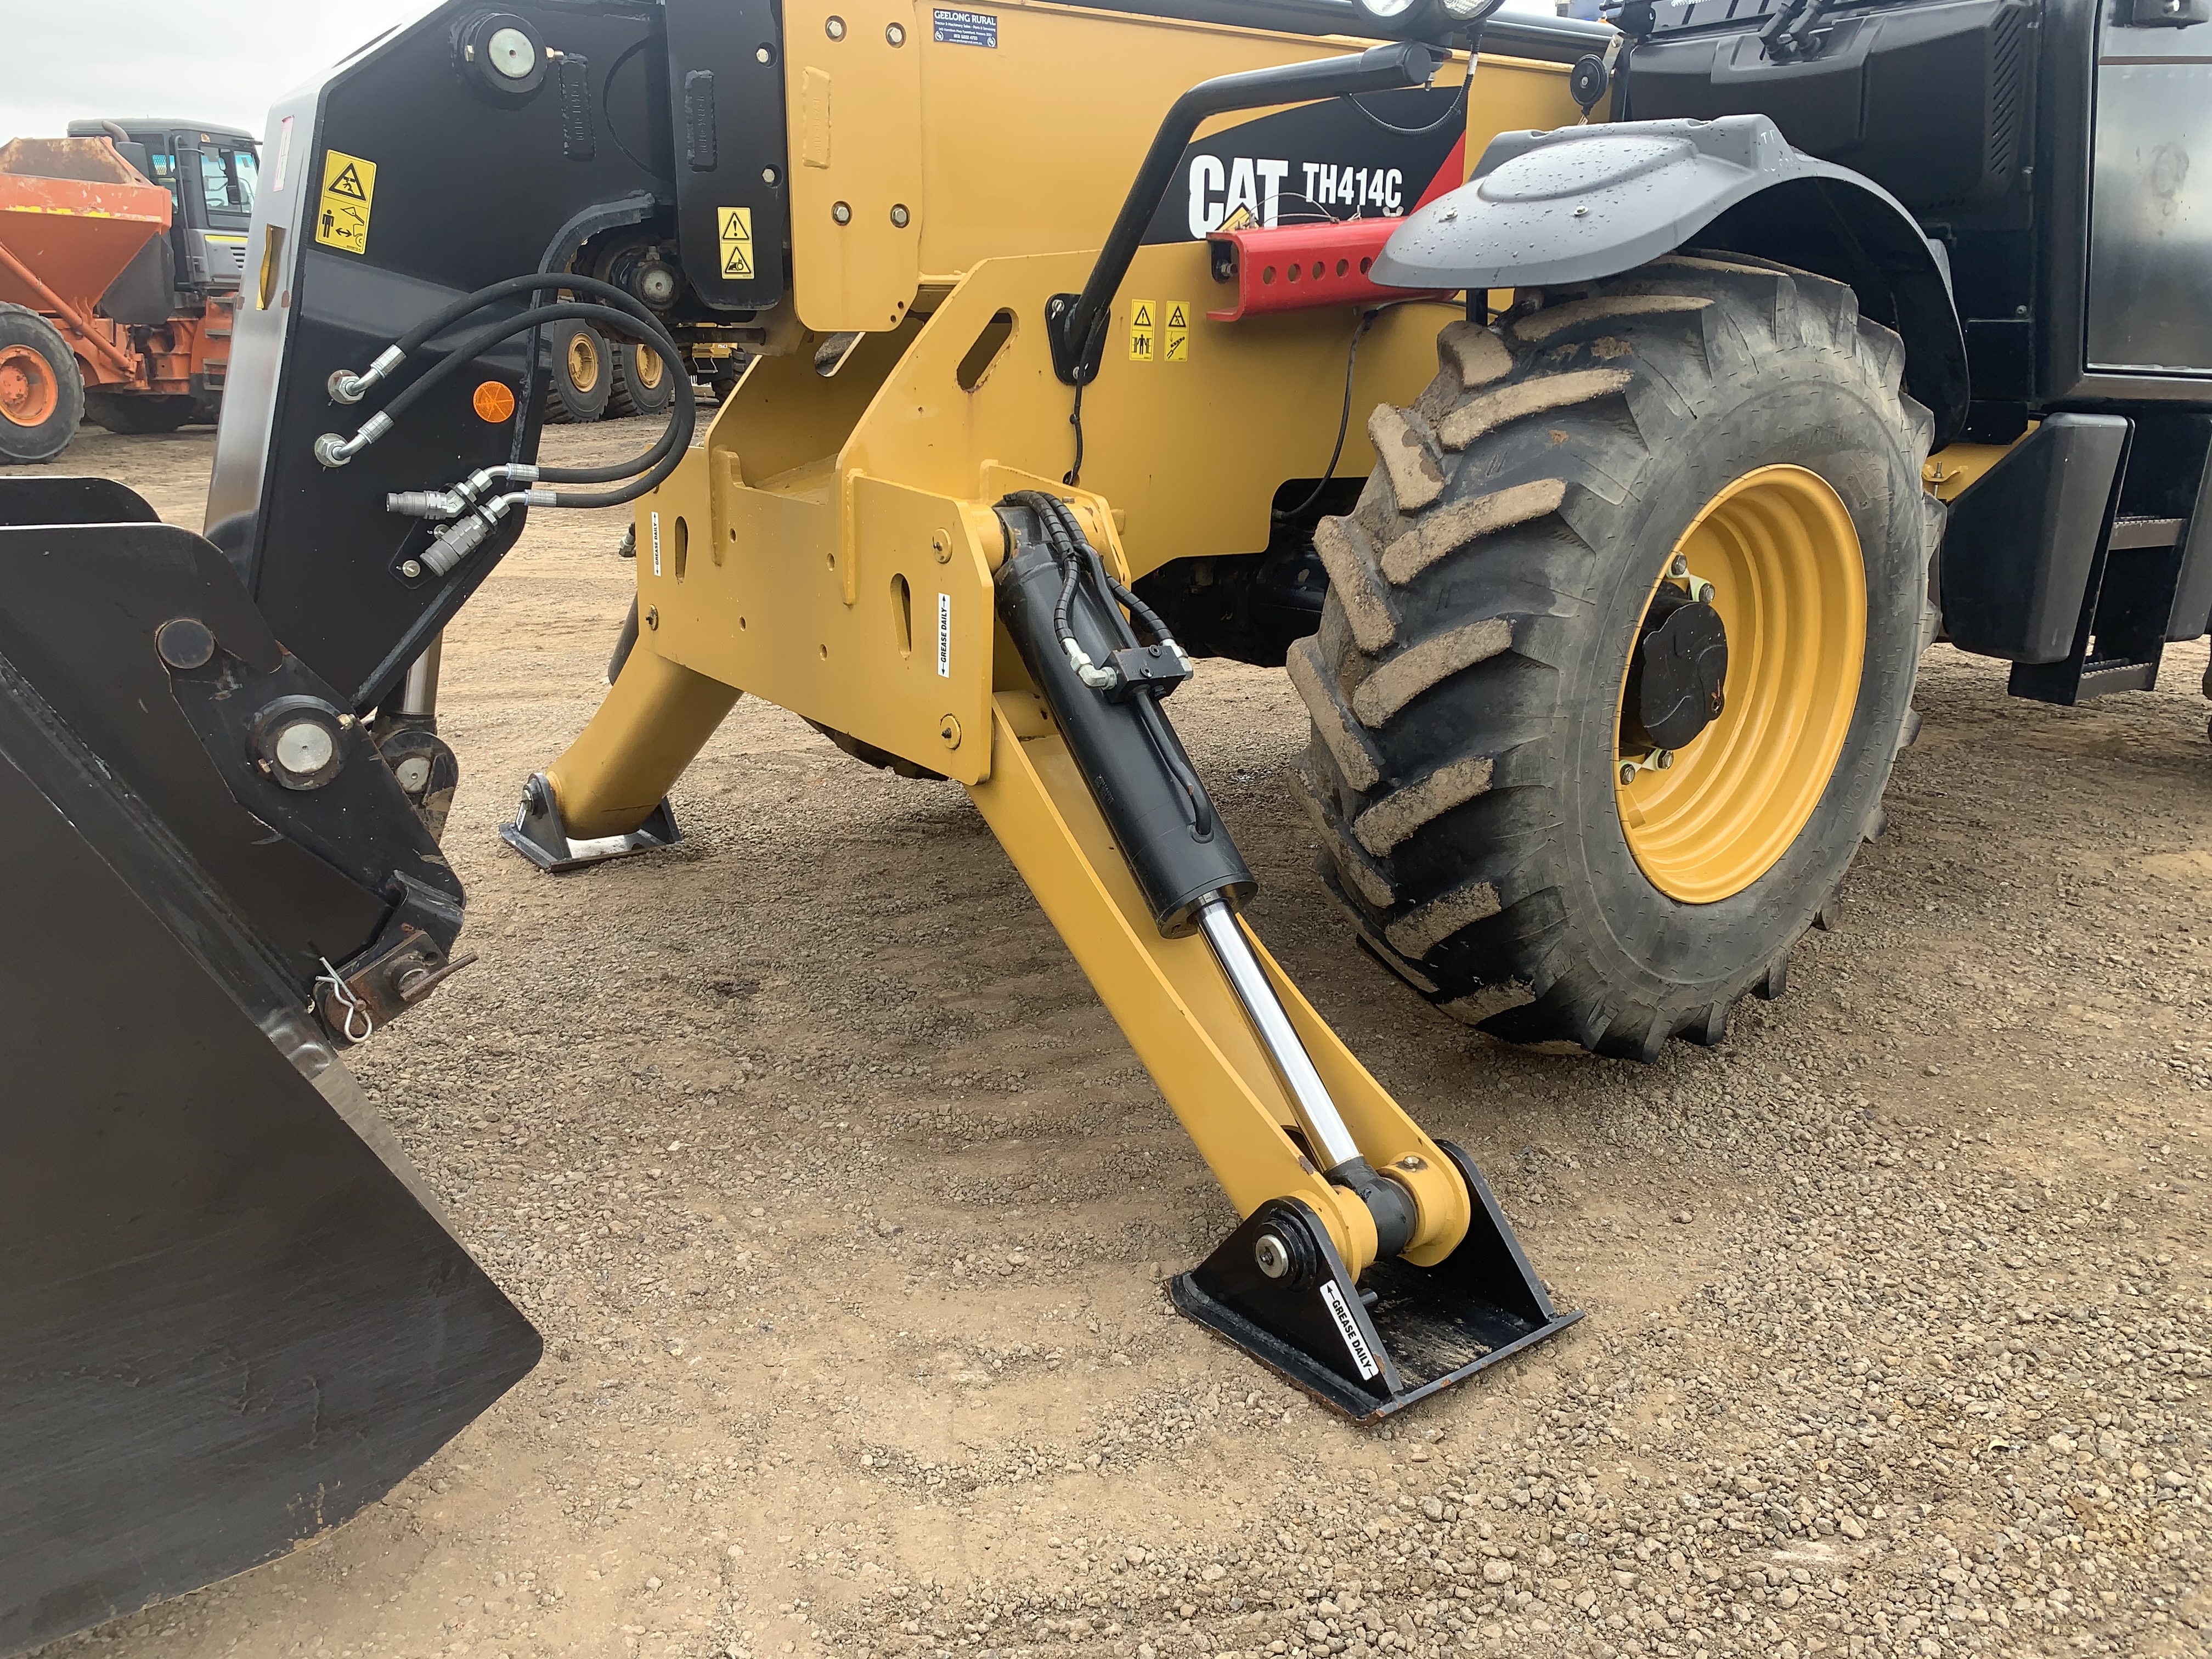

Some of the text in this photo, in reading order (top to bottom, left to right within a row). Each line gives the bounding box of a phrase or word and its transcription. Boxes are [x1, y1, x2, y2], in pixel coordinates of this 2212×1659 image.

[934, 10, 996, 25] GEELONG RURAL
[1189, 155, 1403, 239] CAT TH414C
[1332, 1300, 1372, 1368] GREASE DAILY
